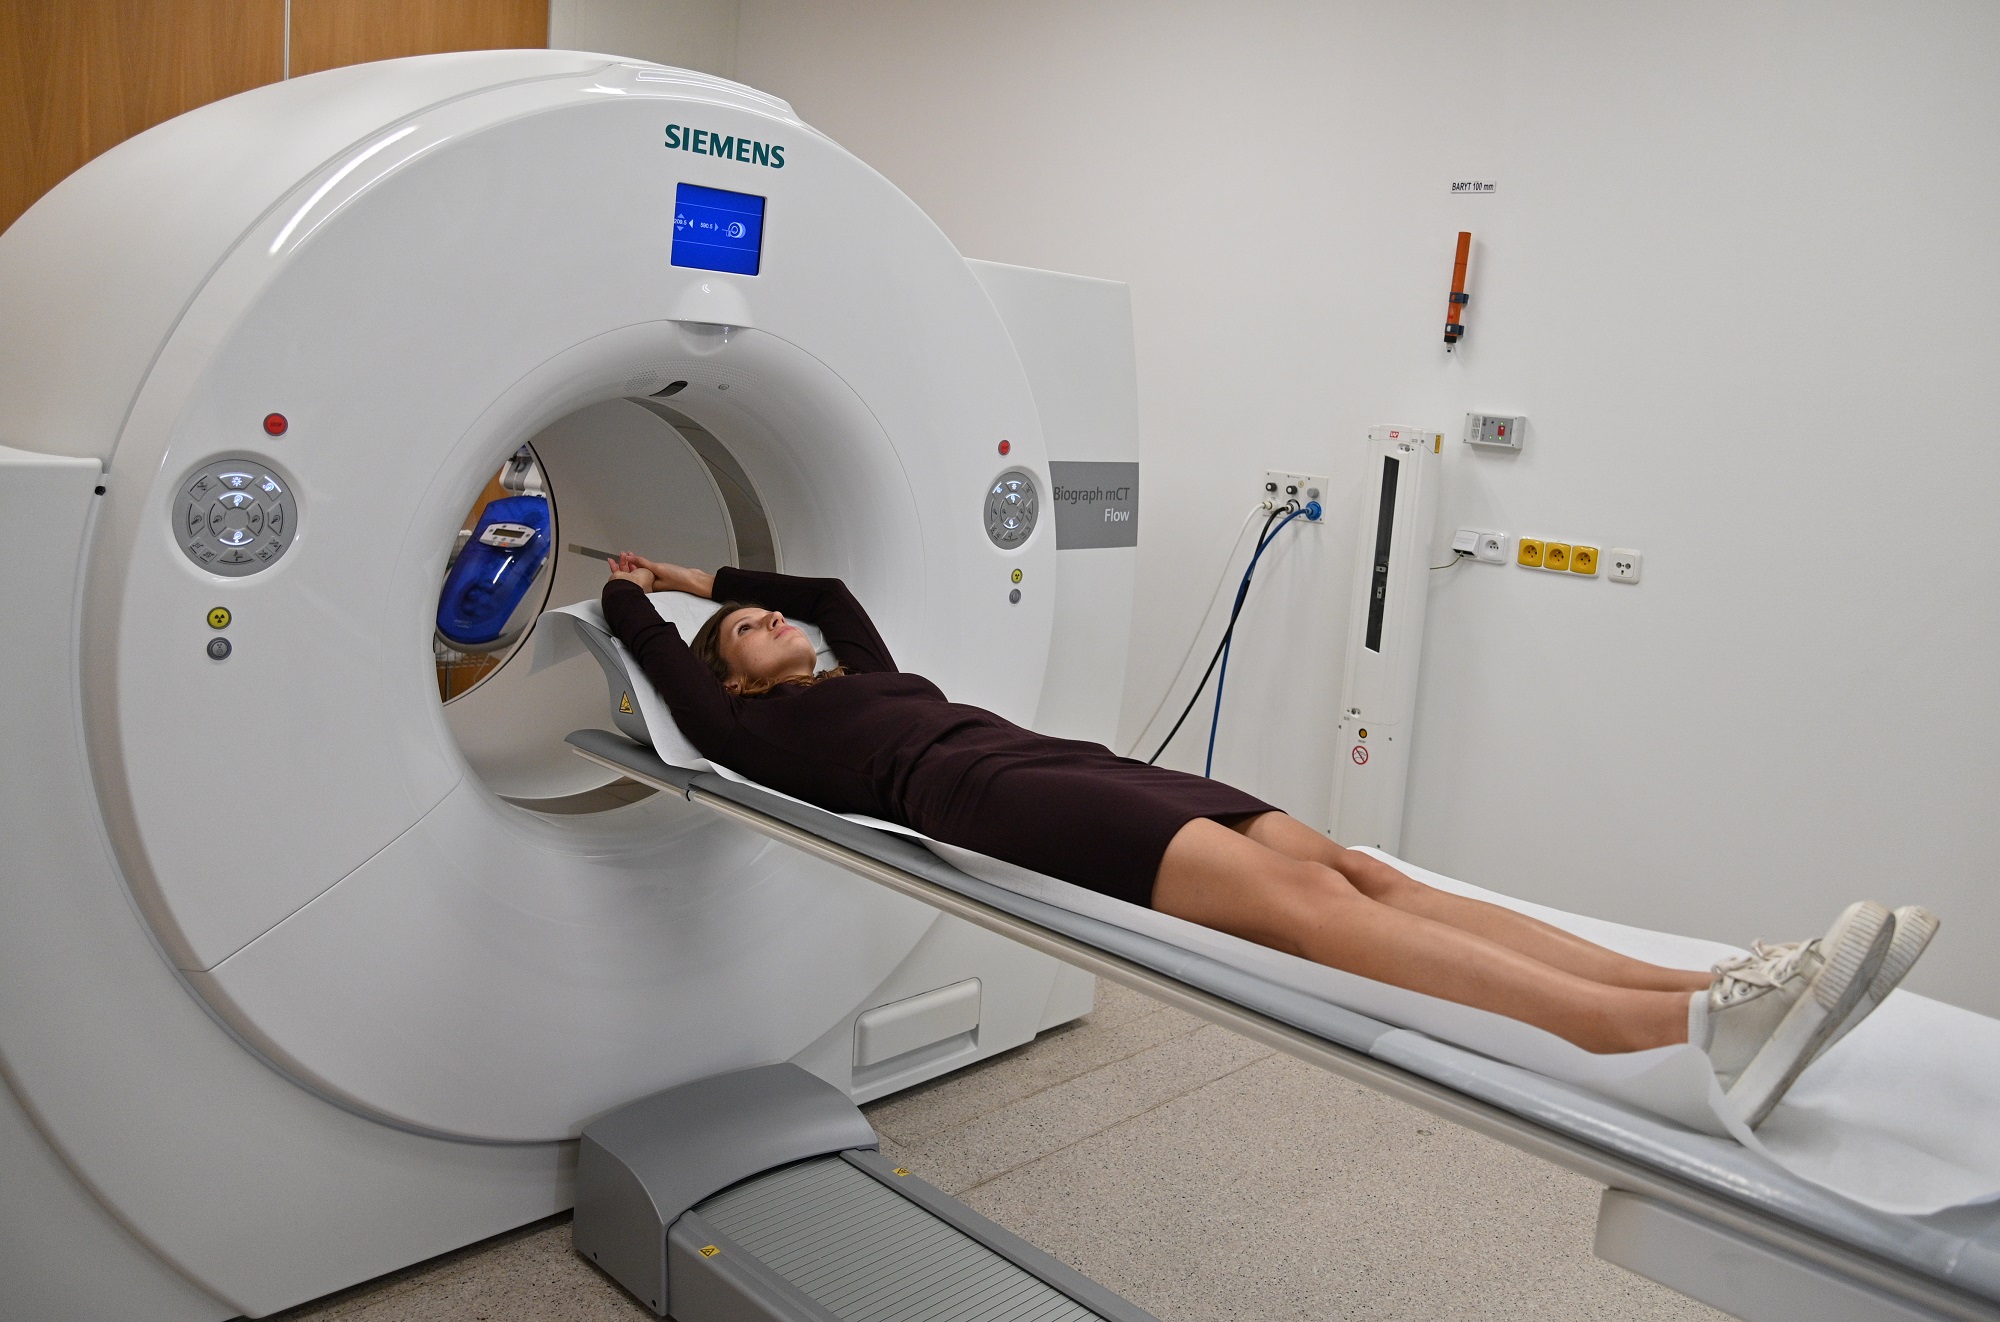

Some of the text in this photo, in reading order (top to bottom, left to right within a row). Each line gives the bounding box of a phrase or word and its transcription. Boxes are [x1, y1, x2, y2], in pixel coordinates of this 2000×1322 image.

[664, 124, 785, 169] SIEMENS
[1452, 182, 1471, 191] BARYT
[1473, 182, 1482, 191] 100
[1053, 486, 1130, 505] Biograph mCT
[1104, 508, 1130, 522] Flow
